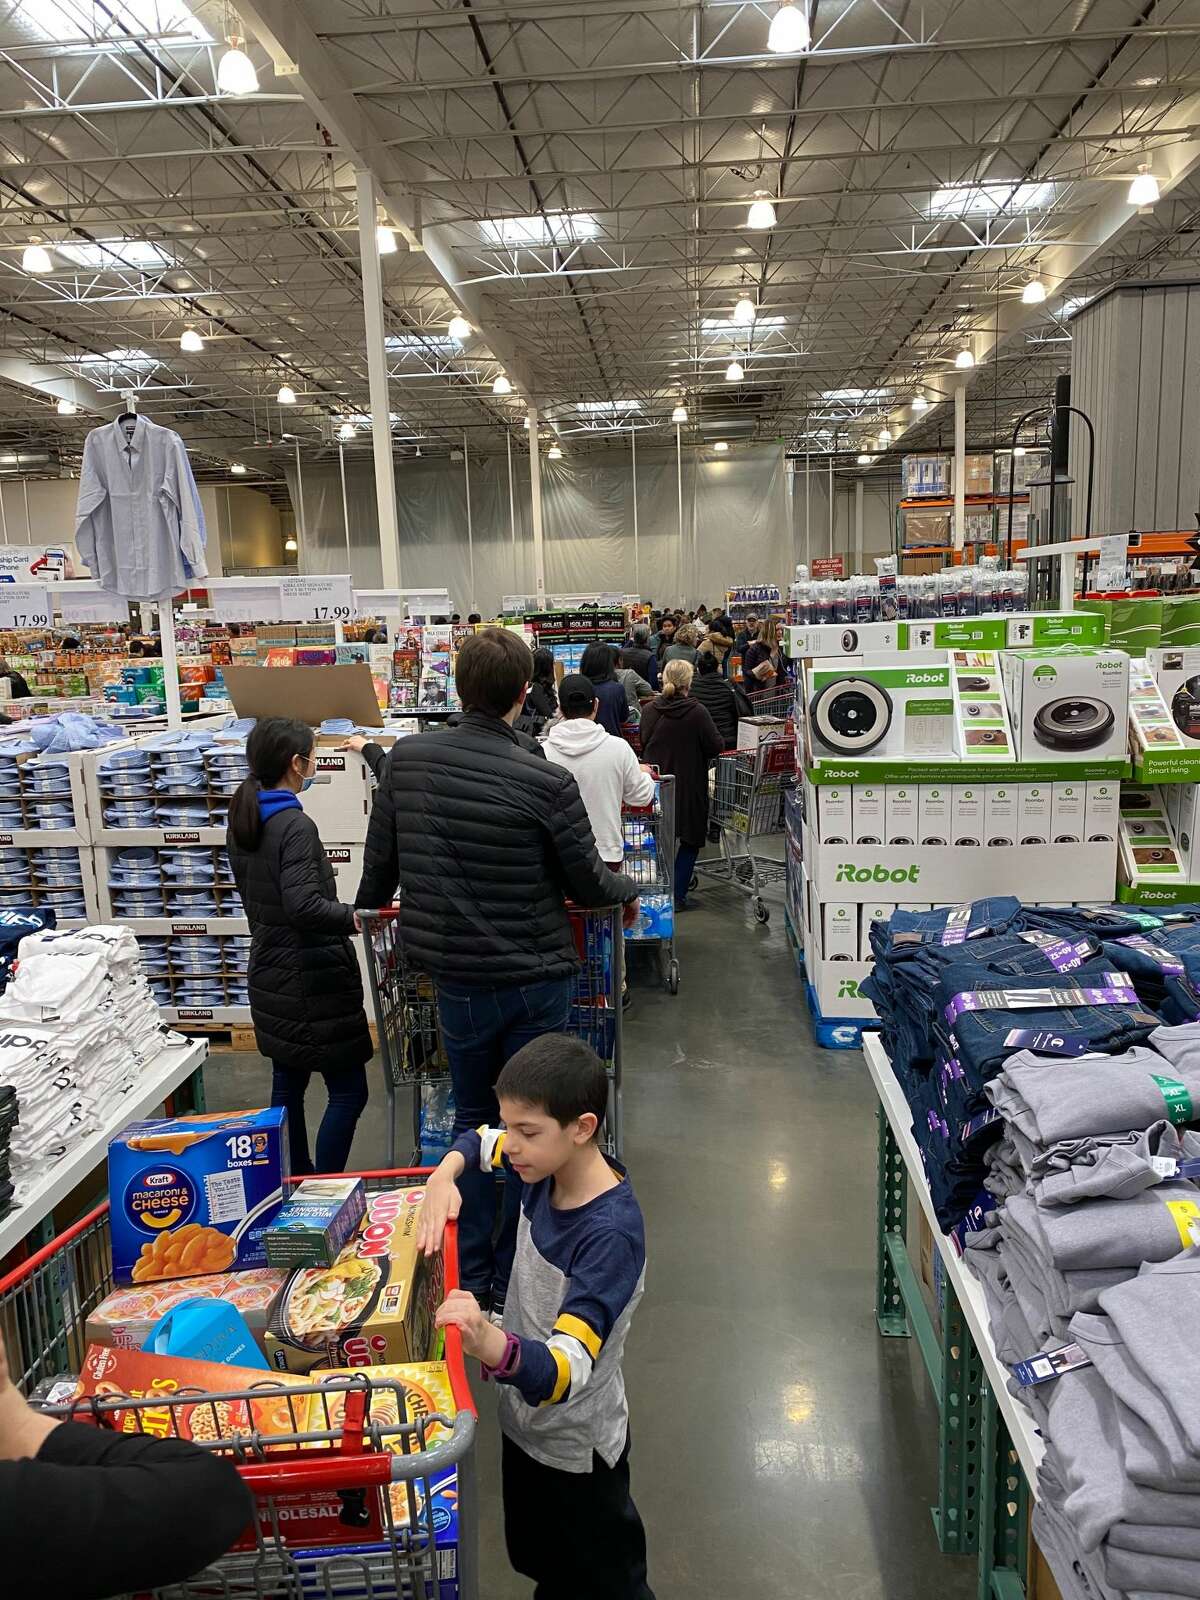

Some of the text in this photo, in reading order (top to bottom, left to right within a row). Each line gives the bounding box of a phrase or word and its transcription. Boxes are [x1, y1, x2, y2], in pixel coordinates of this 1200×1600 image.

[314, 607, 350, 619] 17.99
[13, 615, 48, 627] 17.99
[906, 673, 945, 684] iRobot
[316, 758, 344, 766] KLAND
[1149, 759, 1178, 767] Powerful
[326, 850, 349, 858] LAND
[836, 864, 920, 883] iRobot
[1174, 1103, 1187, 1113] XL
[225, 1135, 252, 1159] 18
[227, 1159, 253, 1168] boxes
[149, 1176, 169, 1184] Kraft
[132, 1187, 188, 1200] macaroni &
[357, 1192, 404, 1259] UDON
[402, 1204, 417, 1237] NONGSHIM
[344, 1337, 373, 1367] UD
